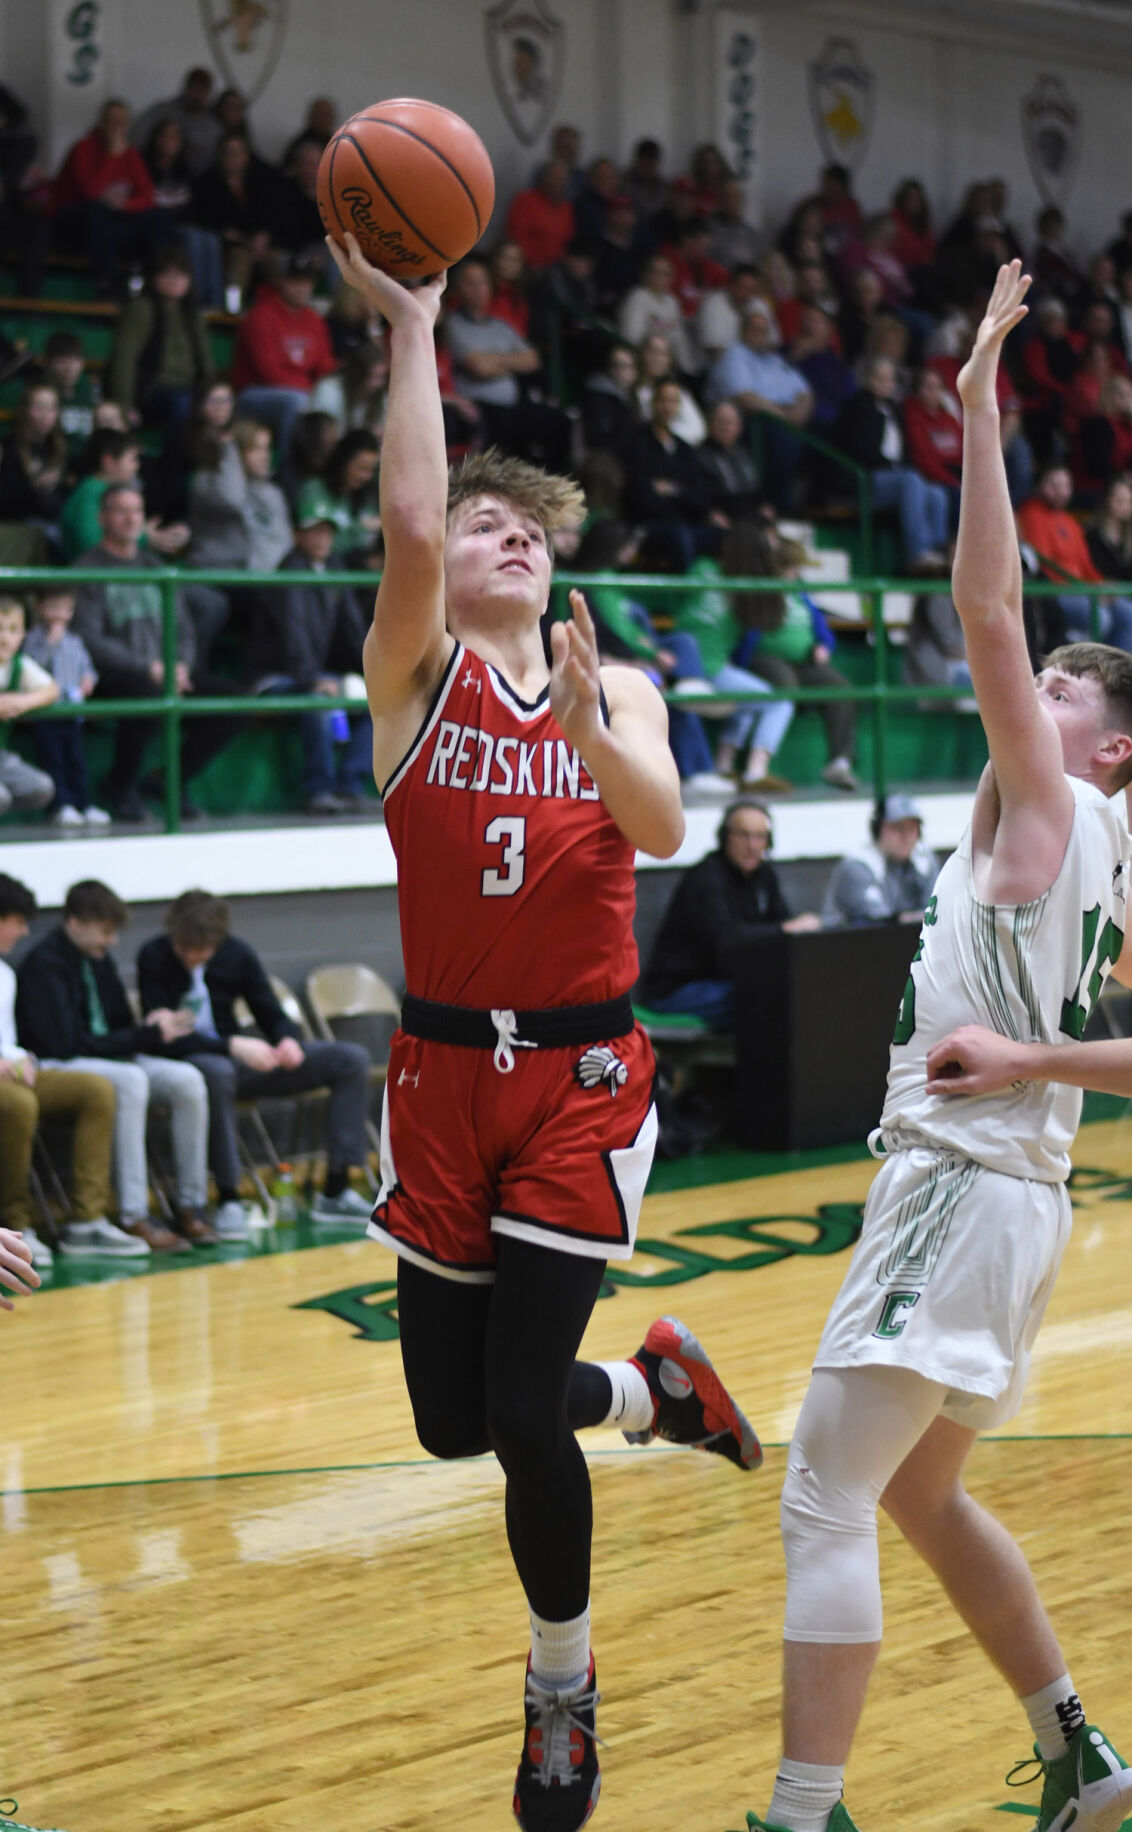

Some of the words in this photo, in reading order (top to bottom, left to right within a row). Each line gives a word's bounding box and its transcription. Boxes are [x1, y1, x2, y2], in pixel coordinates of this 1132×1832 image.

[341, 187, 426, 265] Rawlings
[481, 816, 526, 897] 3
[872, 1291, 921, 1340] C
